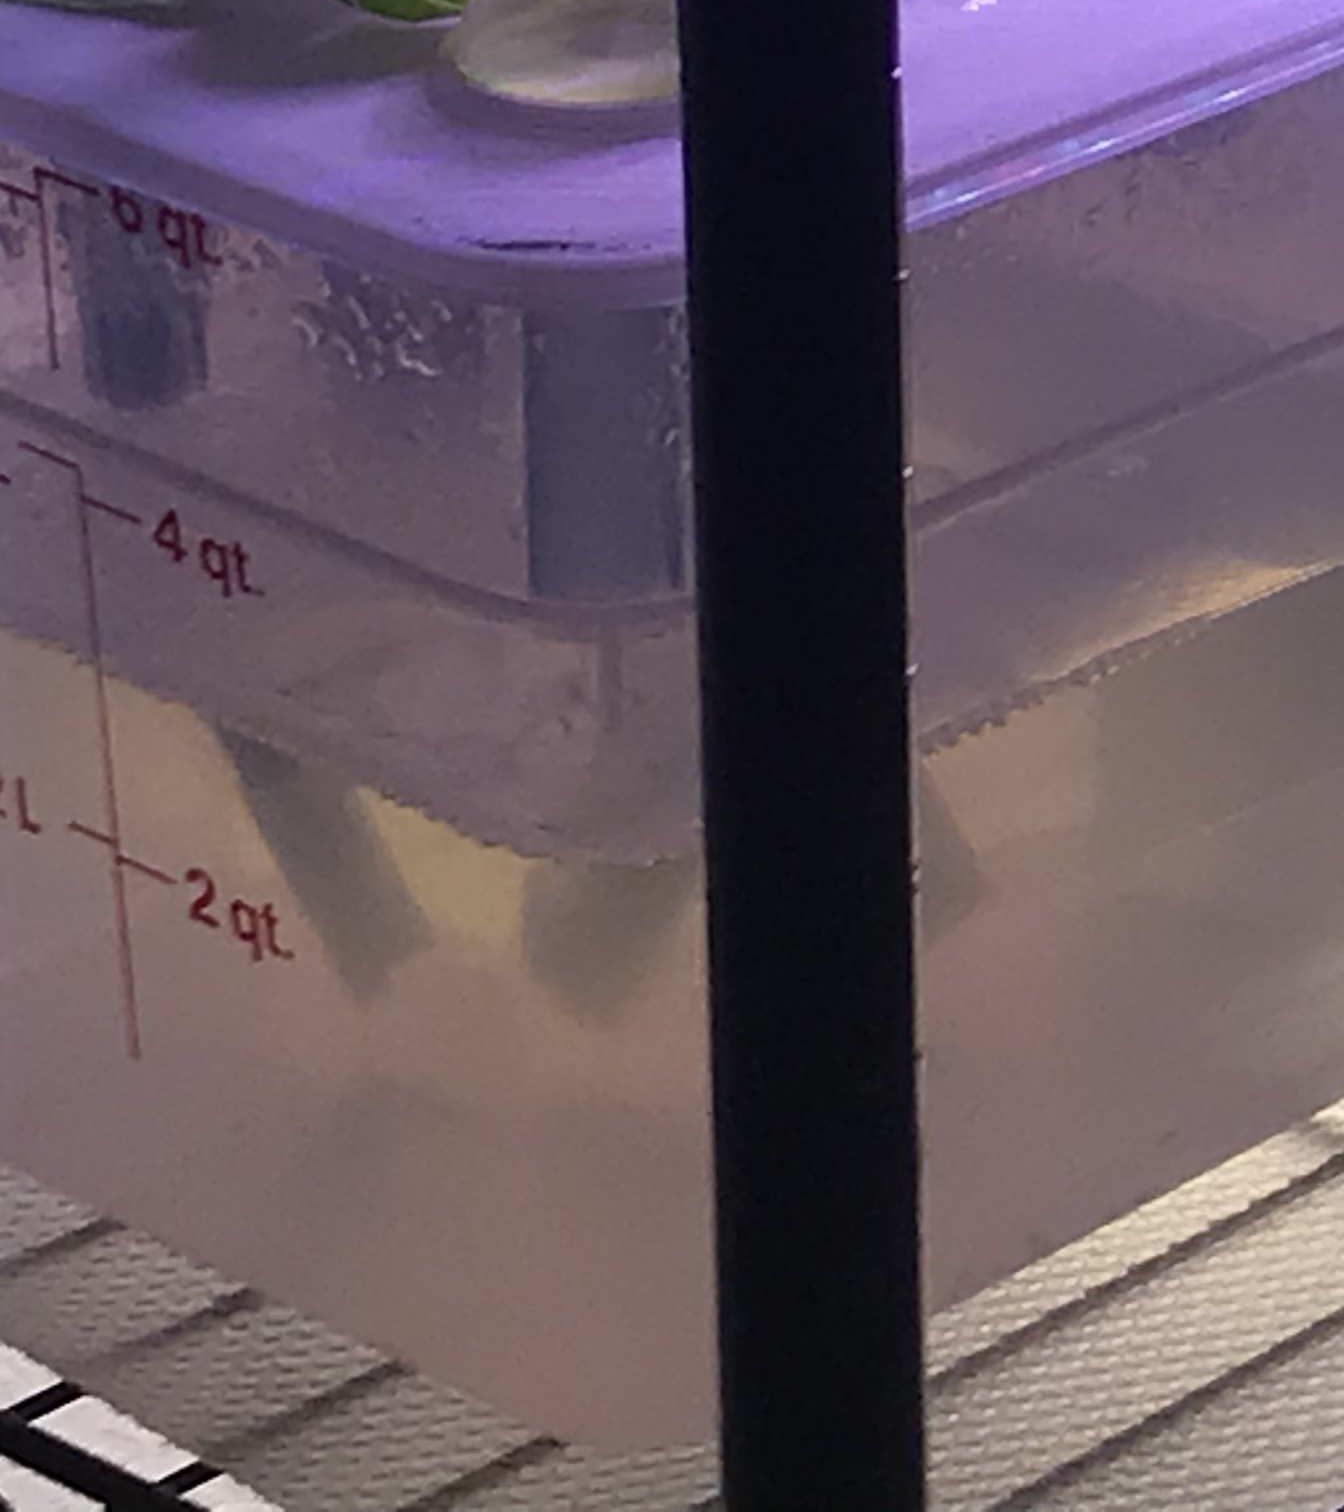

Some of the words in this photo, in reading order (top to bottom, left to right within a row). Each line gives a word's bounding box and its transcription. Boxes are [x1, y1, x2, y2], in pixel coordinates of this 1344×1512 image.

[110, 186, 144, 234] 6
[153, 508, 188, 562] 4
[0, 773, 43, 834] L
[185, 868, 219, 928] 2
